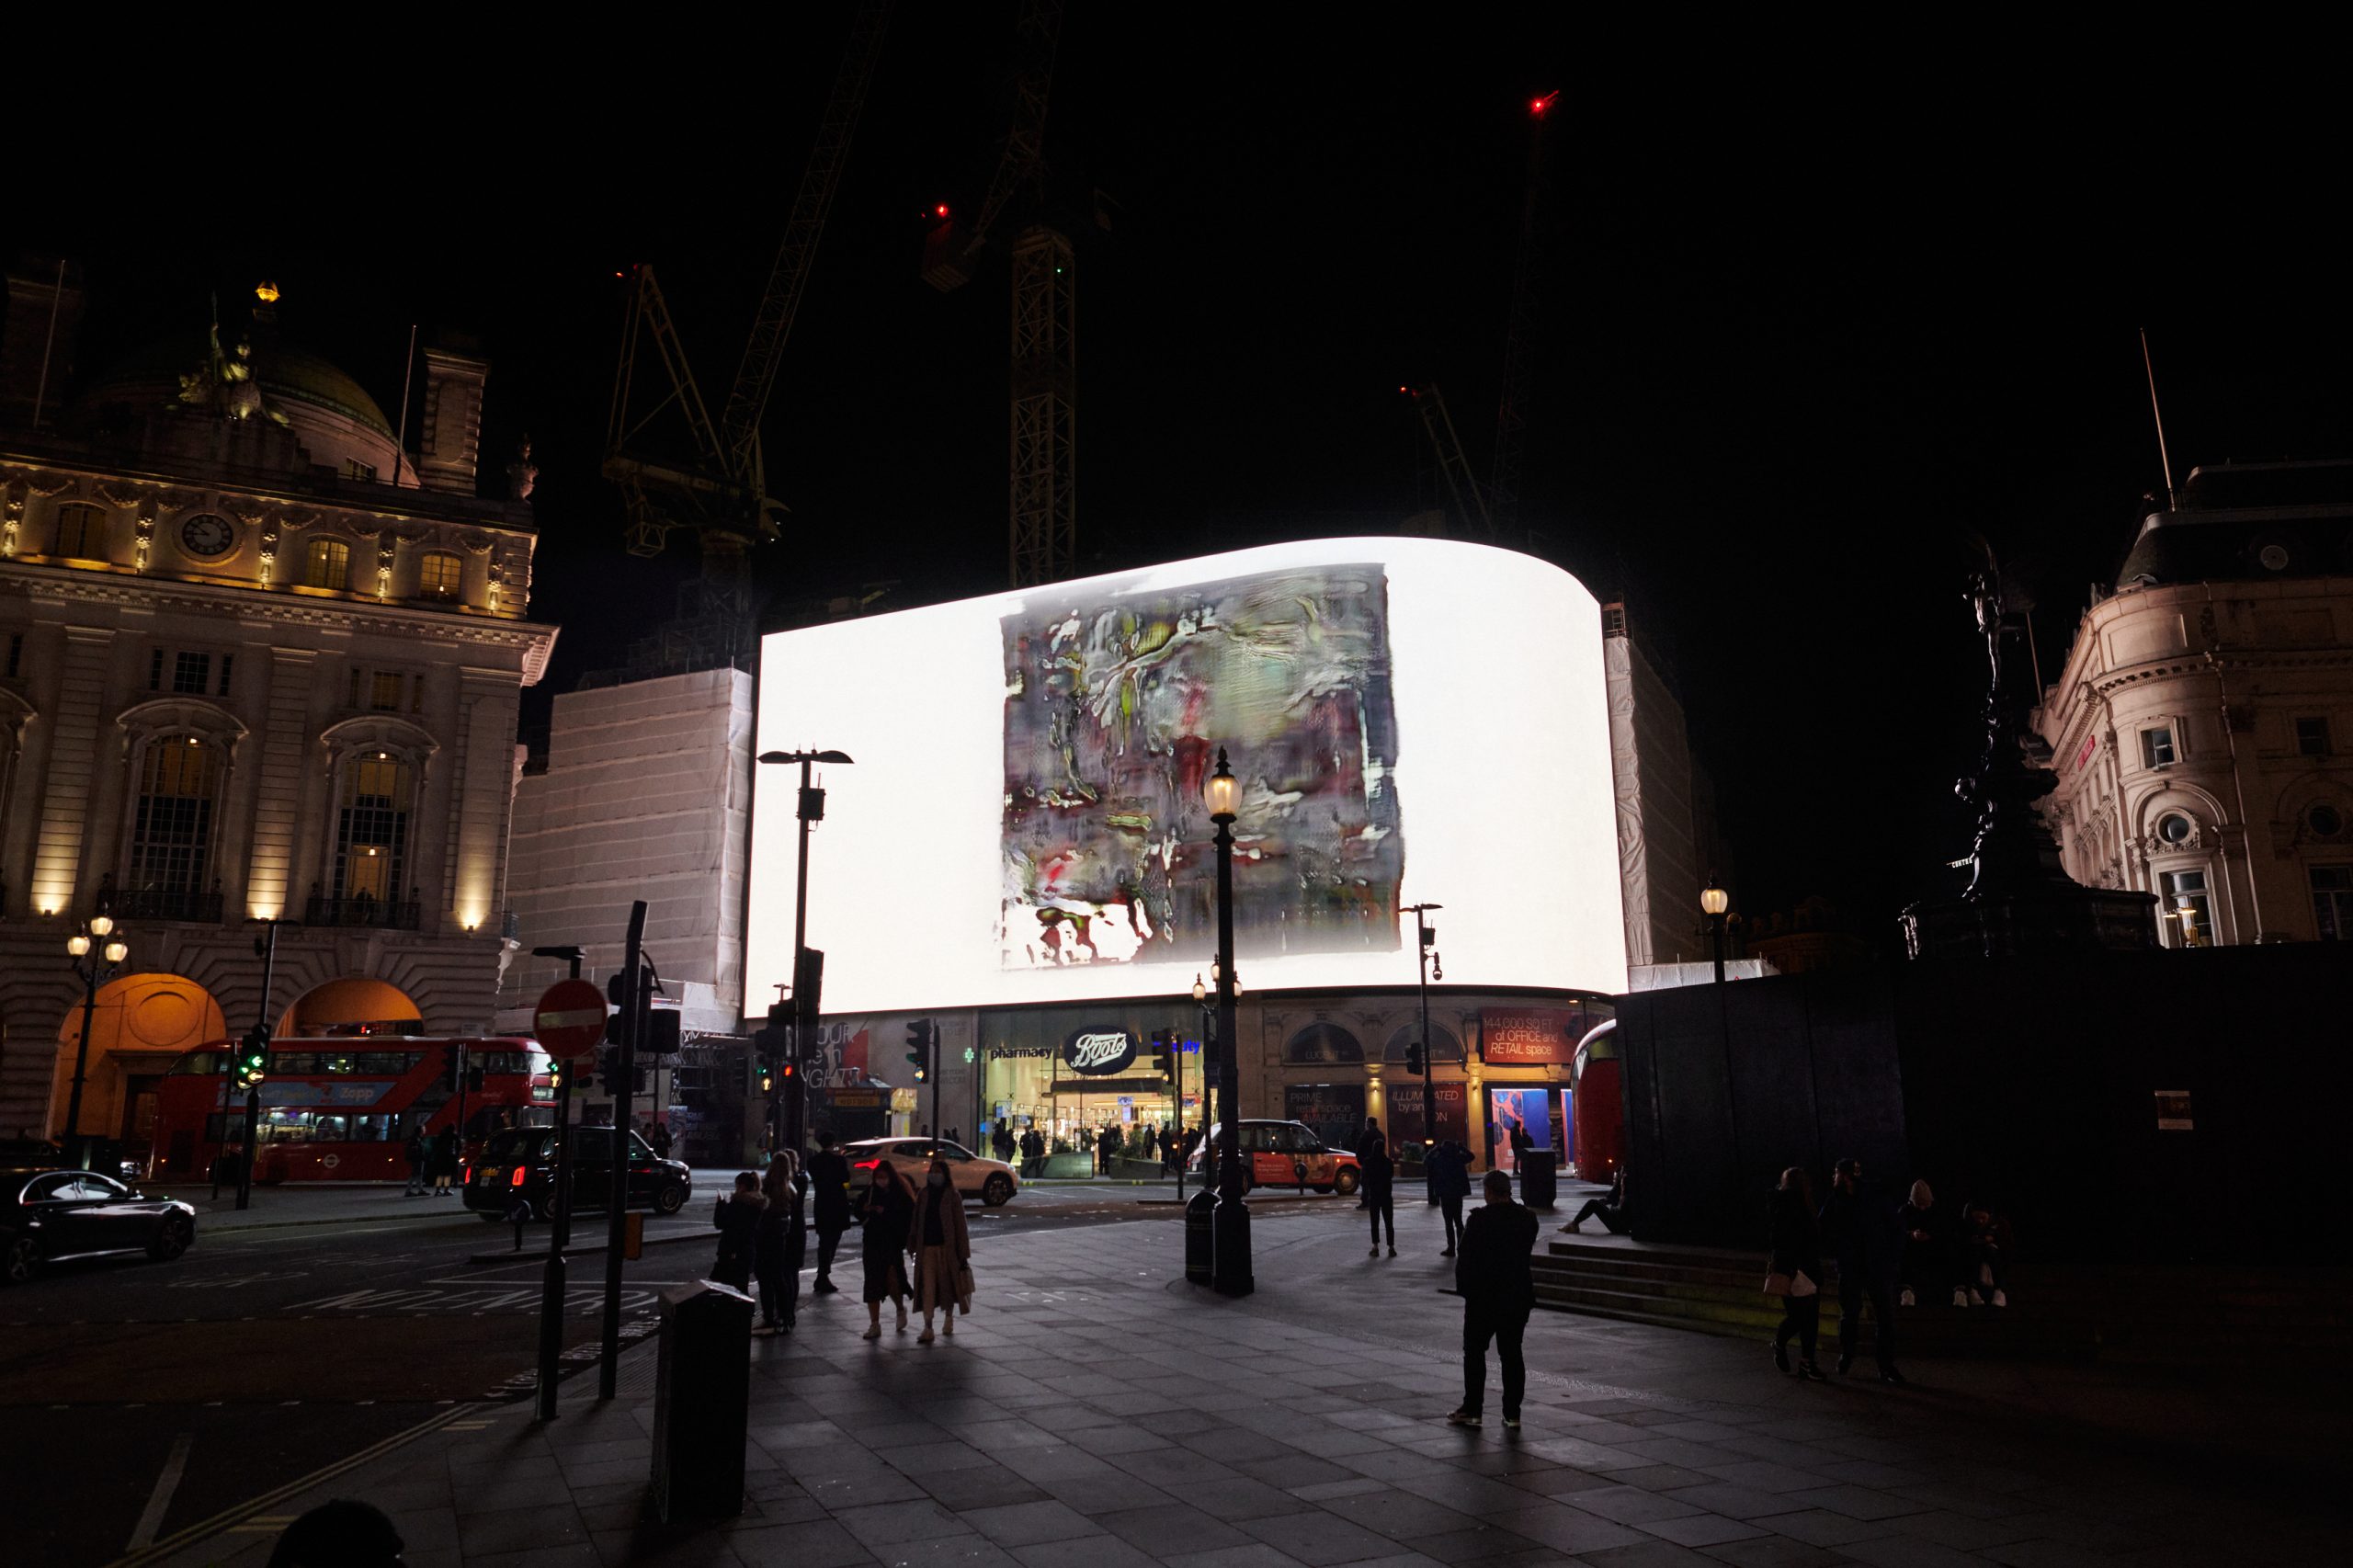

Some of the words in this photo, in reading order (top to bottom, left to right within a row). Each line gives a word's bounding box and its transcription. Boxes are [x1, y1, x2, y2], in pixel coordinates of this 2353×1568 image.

[1483, 1017, 1524, 1030] 144,000
[1526, 1017, 1540, 1029] SQ
[1541, 1017, 1553, 1029] FT
[817, 1024, 854, 1044] OUR
[1495, 1028, 1506, 1041] of
[1507, 1029, 1541, 1042] OFFICE
[1543, 1030, 1559, 1043] and
[990, 1046, 1053, 1062] pharmacy
[1070, 1031, 1127, 1068] Boots
[1490, 1041, 1524, 1055] RETAIL
[1526, 1045, 1552, 1057] space
[1290, 1092, 1323, 1103] PRIME
[1392, 1090, 1459, 1102] ILLUMATED
[1398, 1103, 1410, 1114] by
[1412, 1103, 1425, 1112] an
[1302, 1112, 1358, 1123] AVAILABLE
[1421, 1111, 1448, 1122] ION
